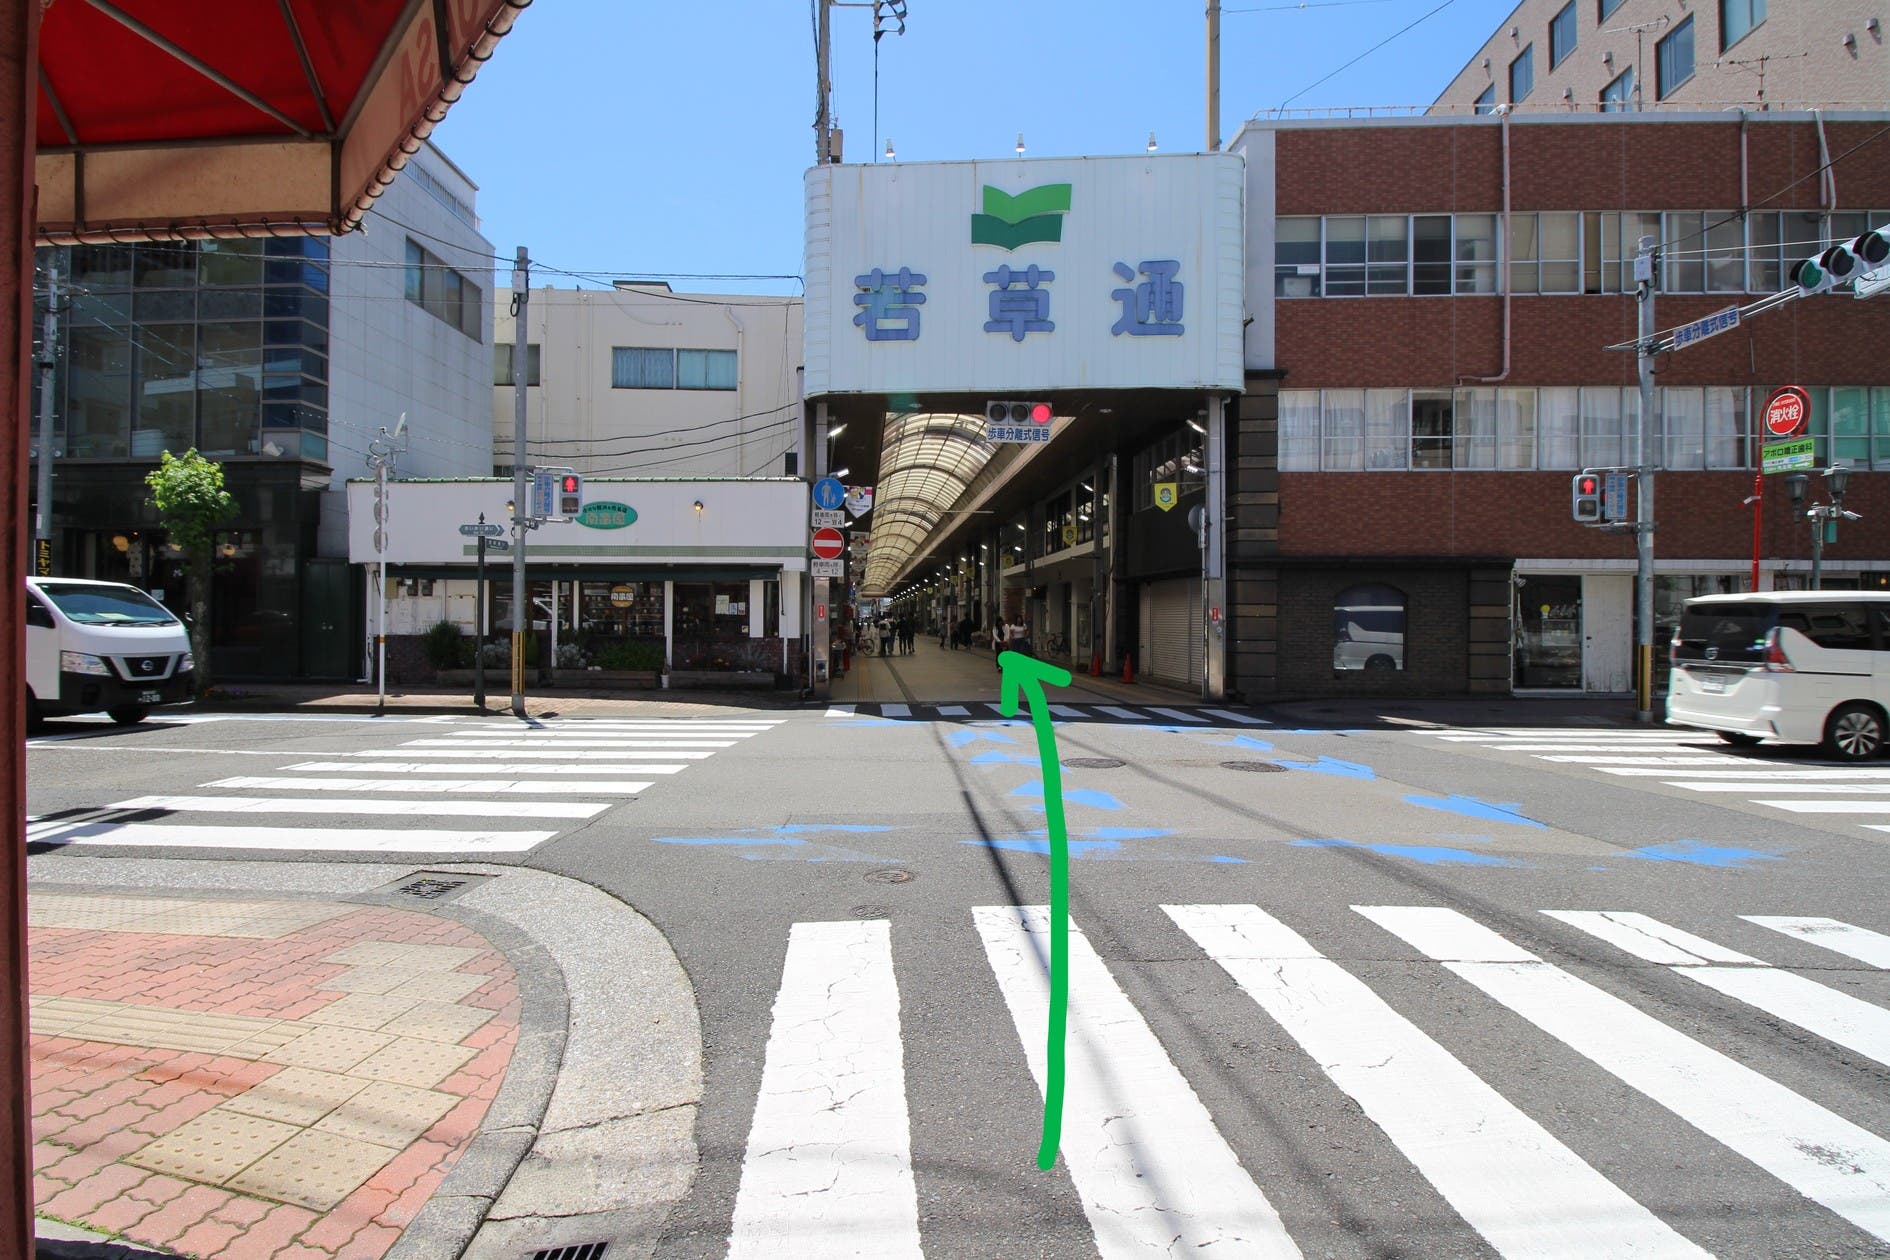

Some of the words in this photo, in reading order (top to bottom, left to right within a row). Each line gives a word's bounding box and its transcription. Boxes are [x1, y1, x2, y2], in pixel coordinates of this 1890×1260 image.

[853, 260, 1186, 343] 若草通
[1675, 307, 1738, 347] 歩車分離式信号
[1770, 405, 1799, 424] 消火栓
[987, 427, 1050, 441] 歩車分離式信号
